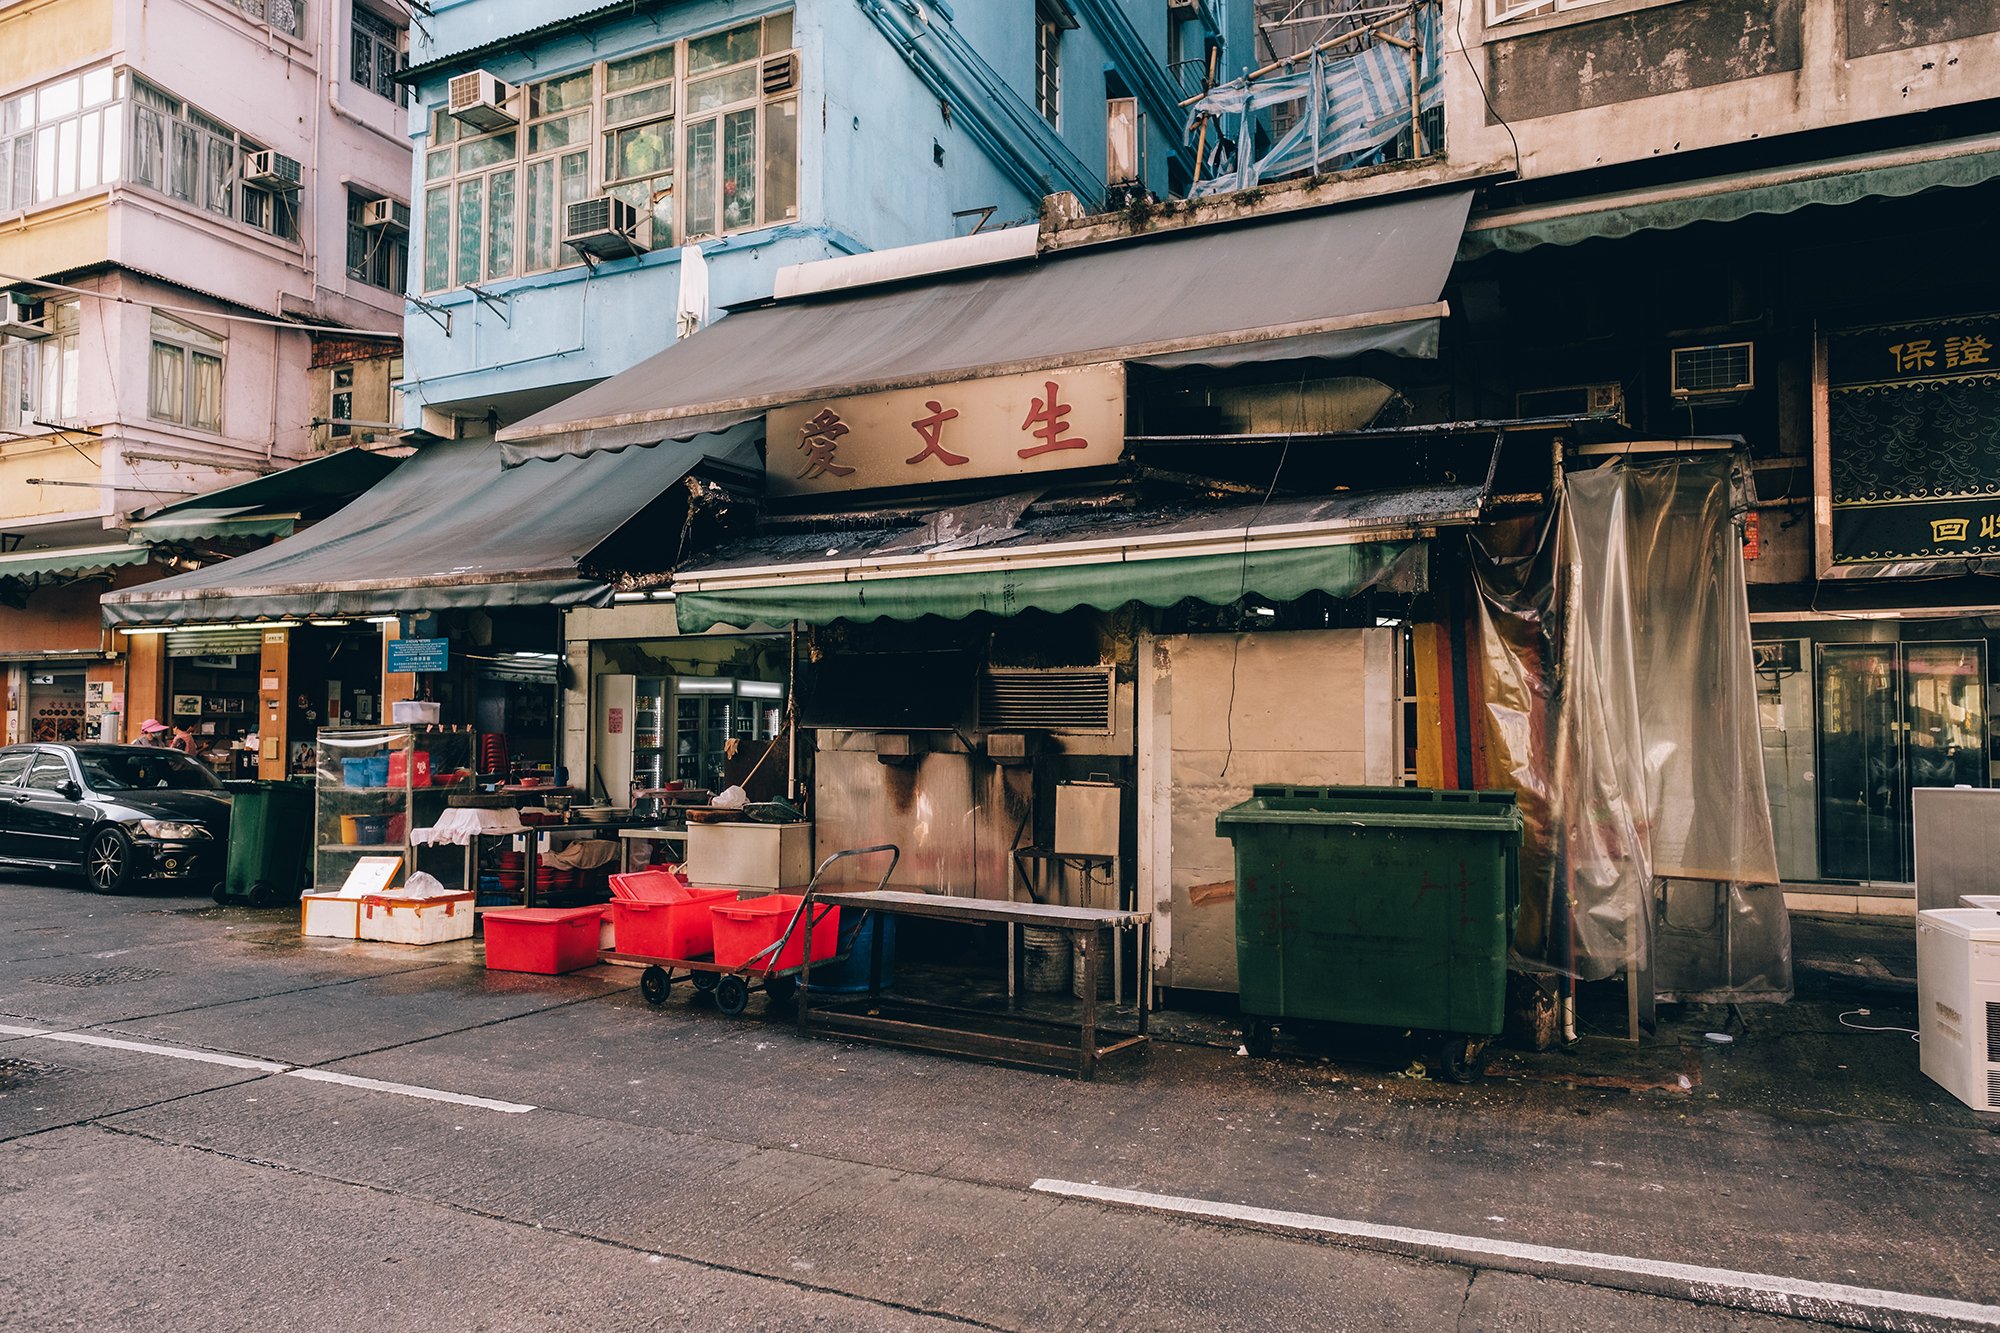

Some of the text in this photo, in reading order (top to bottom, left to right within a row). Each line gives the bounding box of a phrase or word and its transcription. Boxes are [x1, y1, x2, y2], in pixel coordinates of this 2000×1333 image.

[1889, 334, 1993, 373] 保證
[796, 381, 1088, 479] 愛文生
